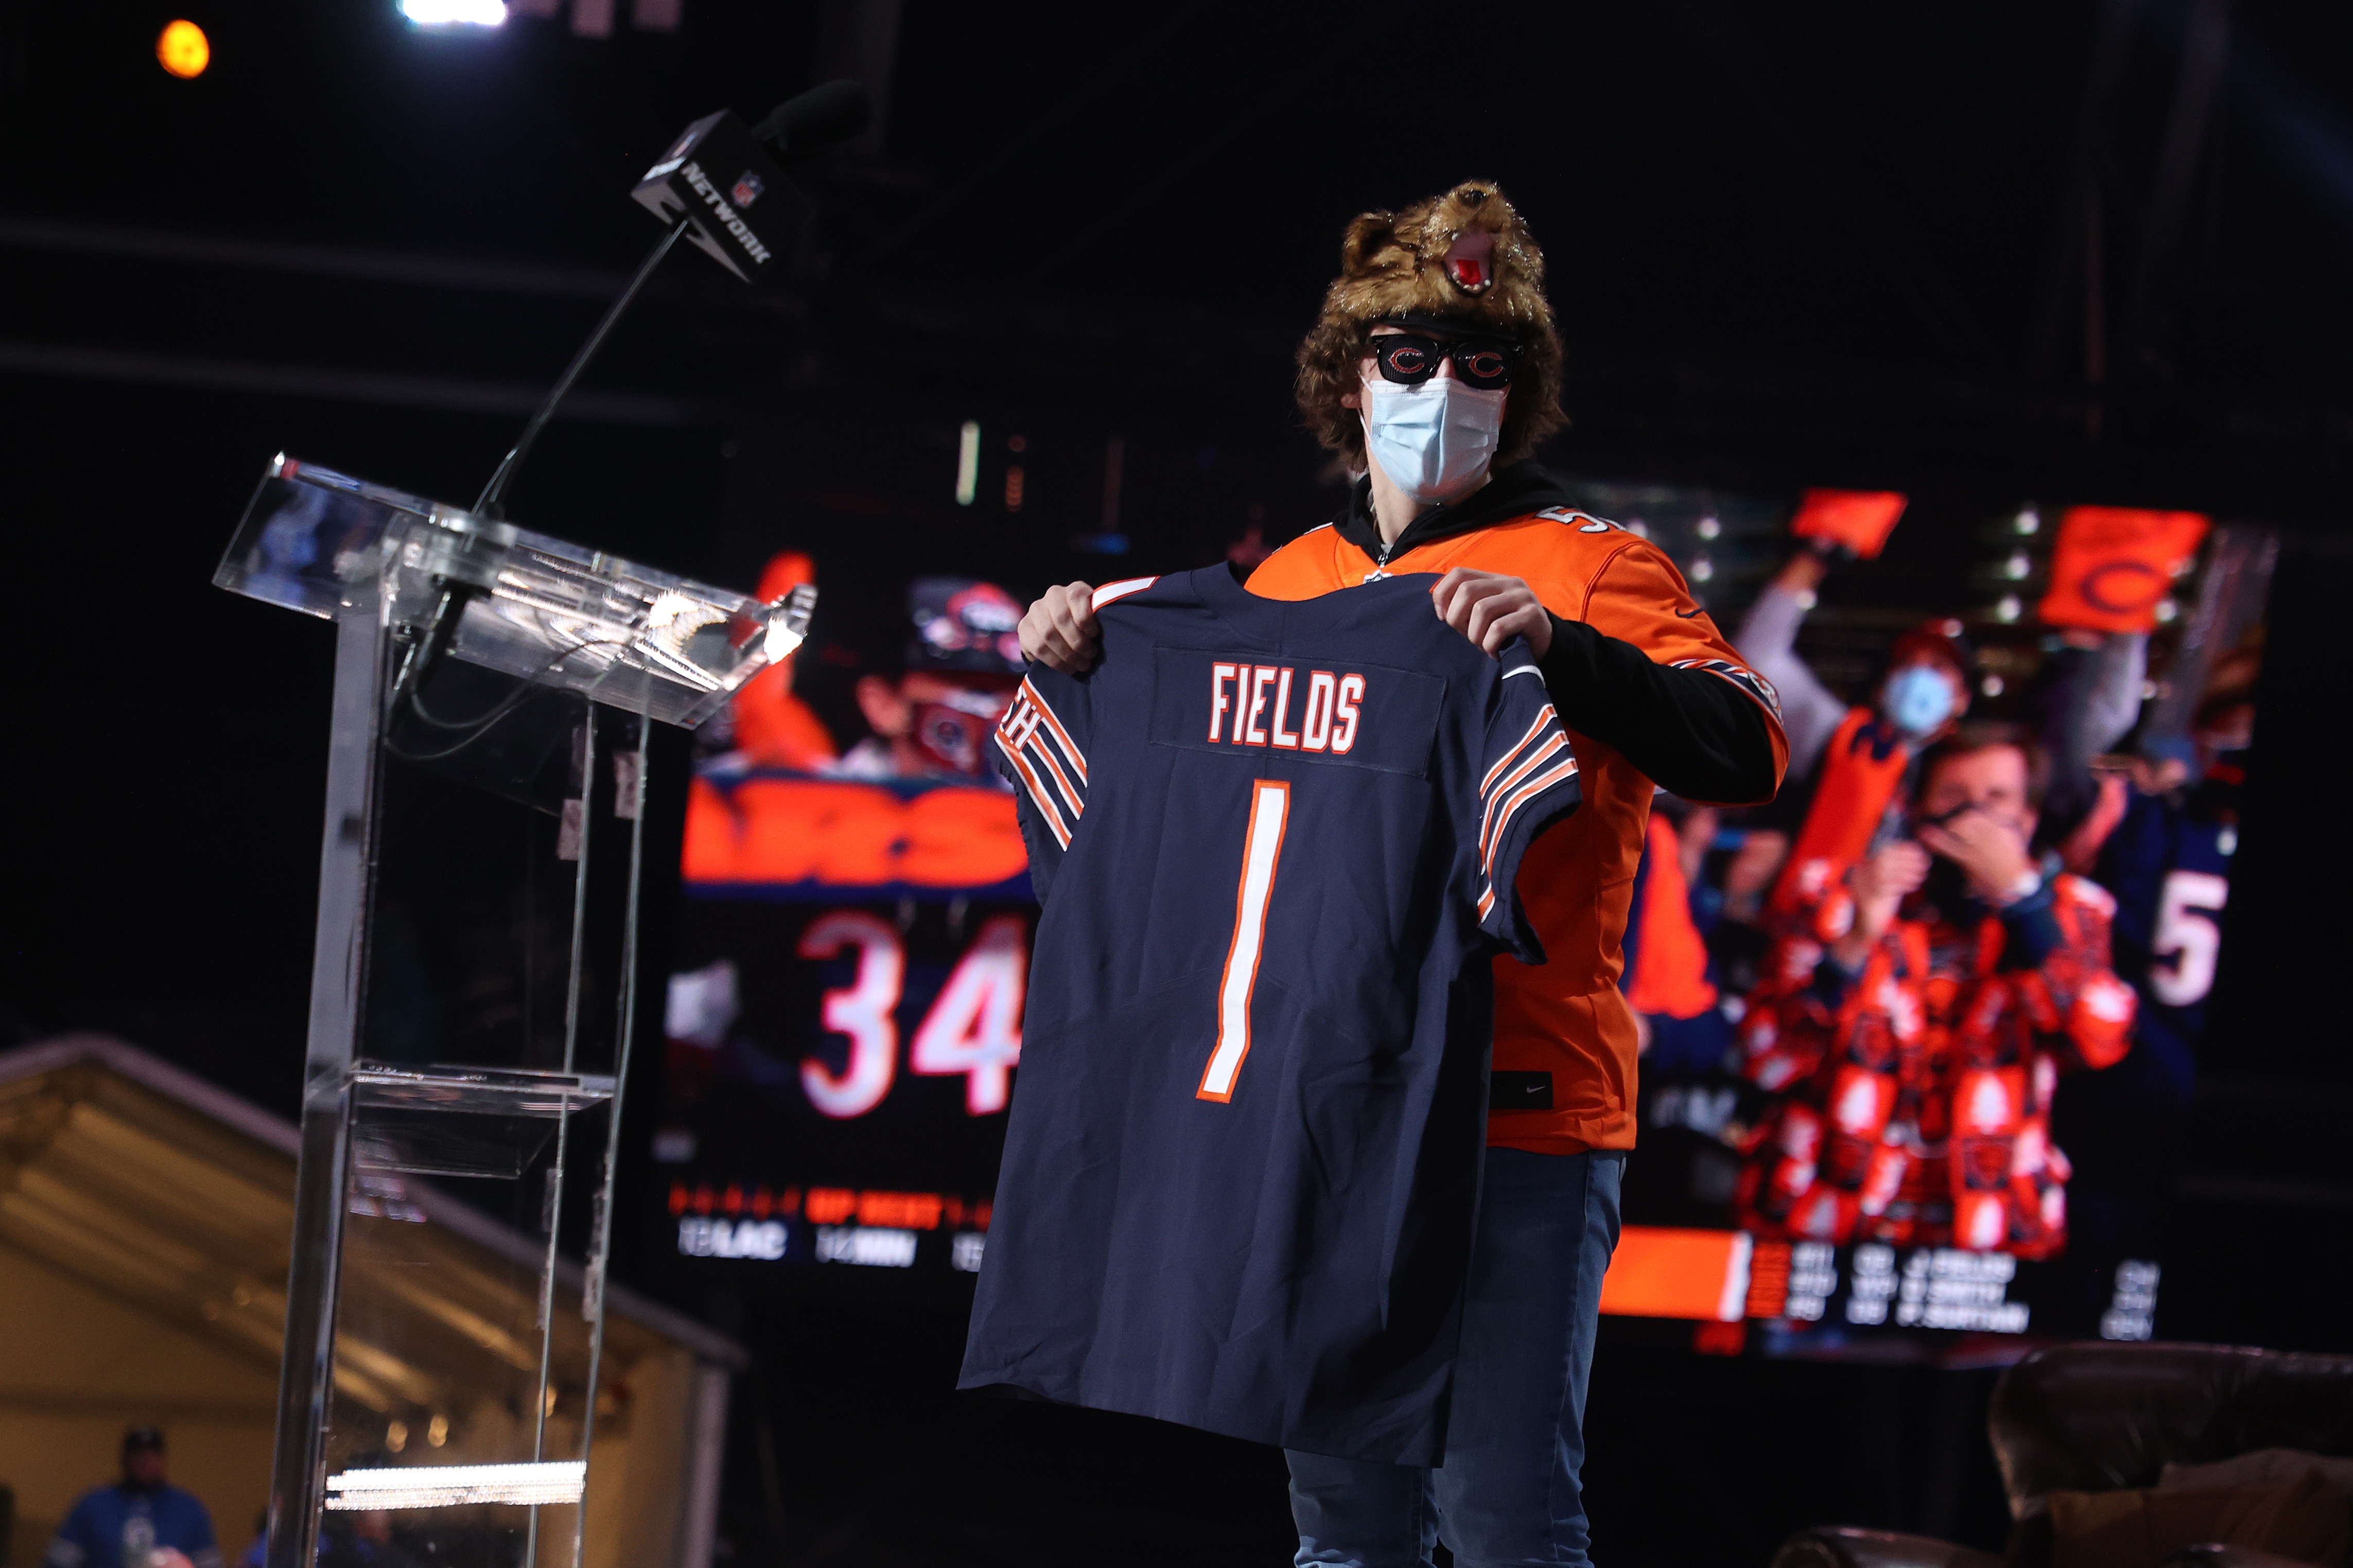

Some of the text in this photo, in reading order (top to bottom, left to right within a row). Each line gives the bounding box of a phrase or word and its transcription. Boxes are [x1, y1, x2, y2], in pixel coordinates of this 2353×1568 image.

[680, 160, 772, 265] NETWORK
[1390, 348, 1424, 373] C
[1469, 352, 1503, 377] C
[1207, 662, 1366, 755] FIELDS
[1195, 779, 1291, 1104] 1
[2150, 870, 2229, 1007] 5
[794, 909, 1030, 1119] 34
